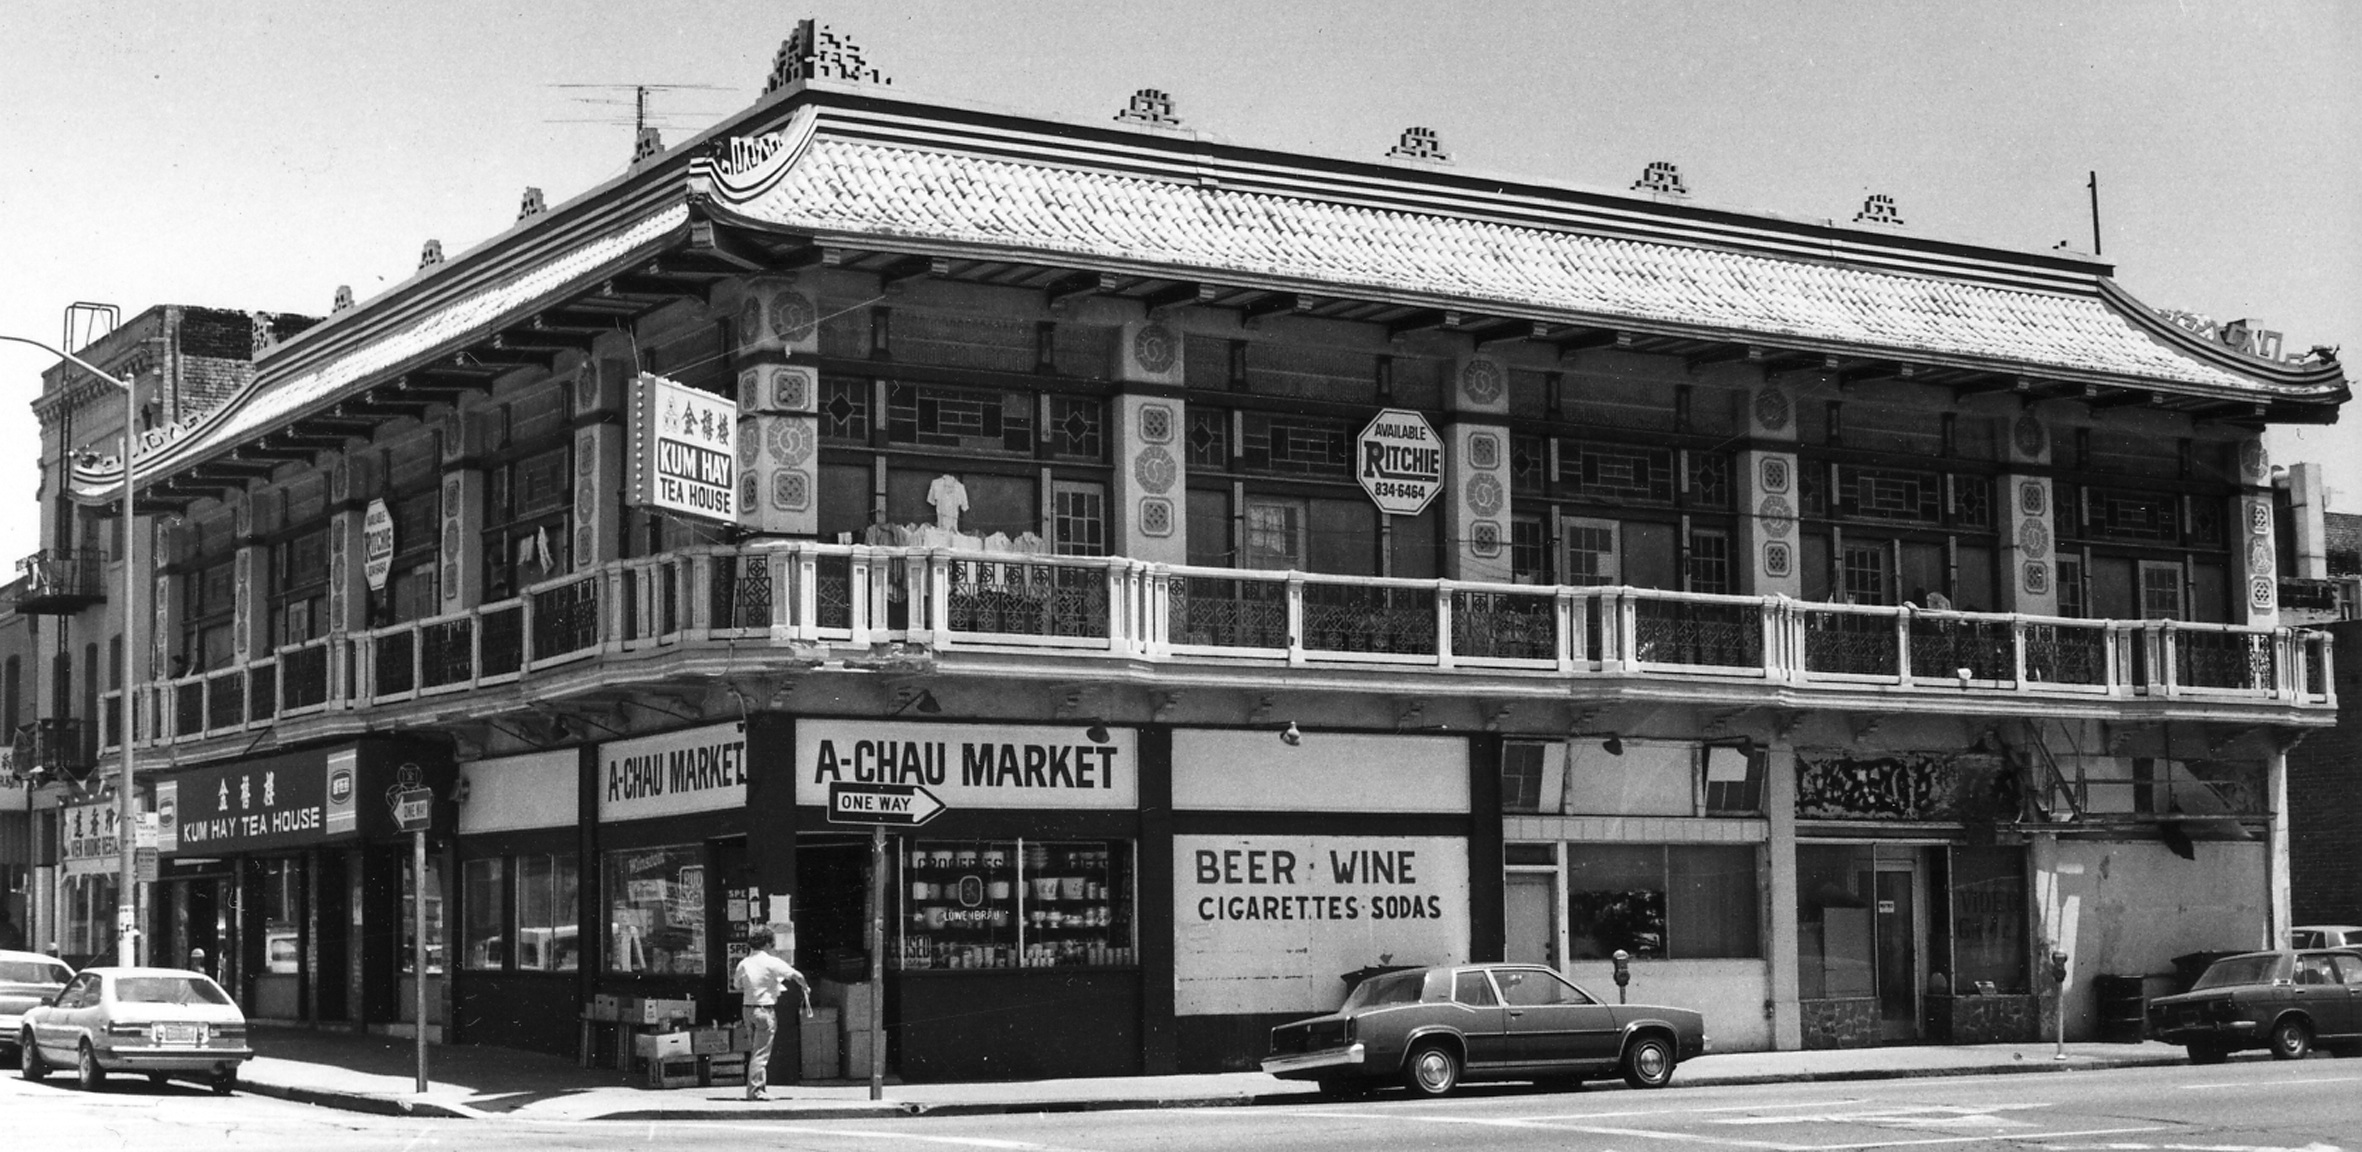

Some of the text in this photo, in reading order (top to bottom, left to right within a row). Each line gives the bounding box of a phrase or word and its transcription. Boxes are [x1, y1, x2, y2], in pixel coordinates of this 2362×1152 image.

[1374, 422, 1427, 441] AVAILABLE
[659, 440, 731, 487] KUM HAY
[1363, 440, 1440, 480] RITCHIE
[660, 477, 731, 514] TEA HOUSE
[1374, 481, 1426, 500] 834-6464
[608, 741, 745, 802] A-CHAU MARKET
[814, 739, 1119, 789] A-CHAU MARKET
[403, 803, 416, 819] ONE
[841, 795, 912, 812] ONE WAY
[183, 820, 208, 843] KUM
[211, 816, 237, 840] HAY
[241, 813, 269, 837] TEA
[272, 805, 320, 833] HOUSE
[1195, 849, 1417, 885] BEER WINE
